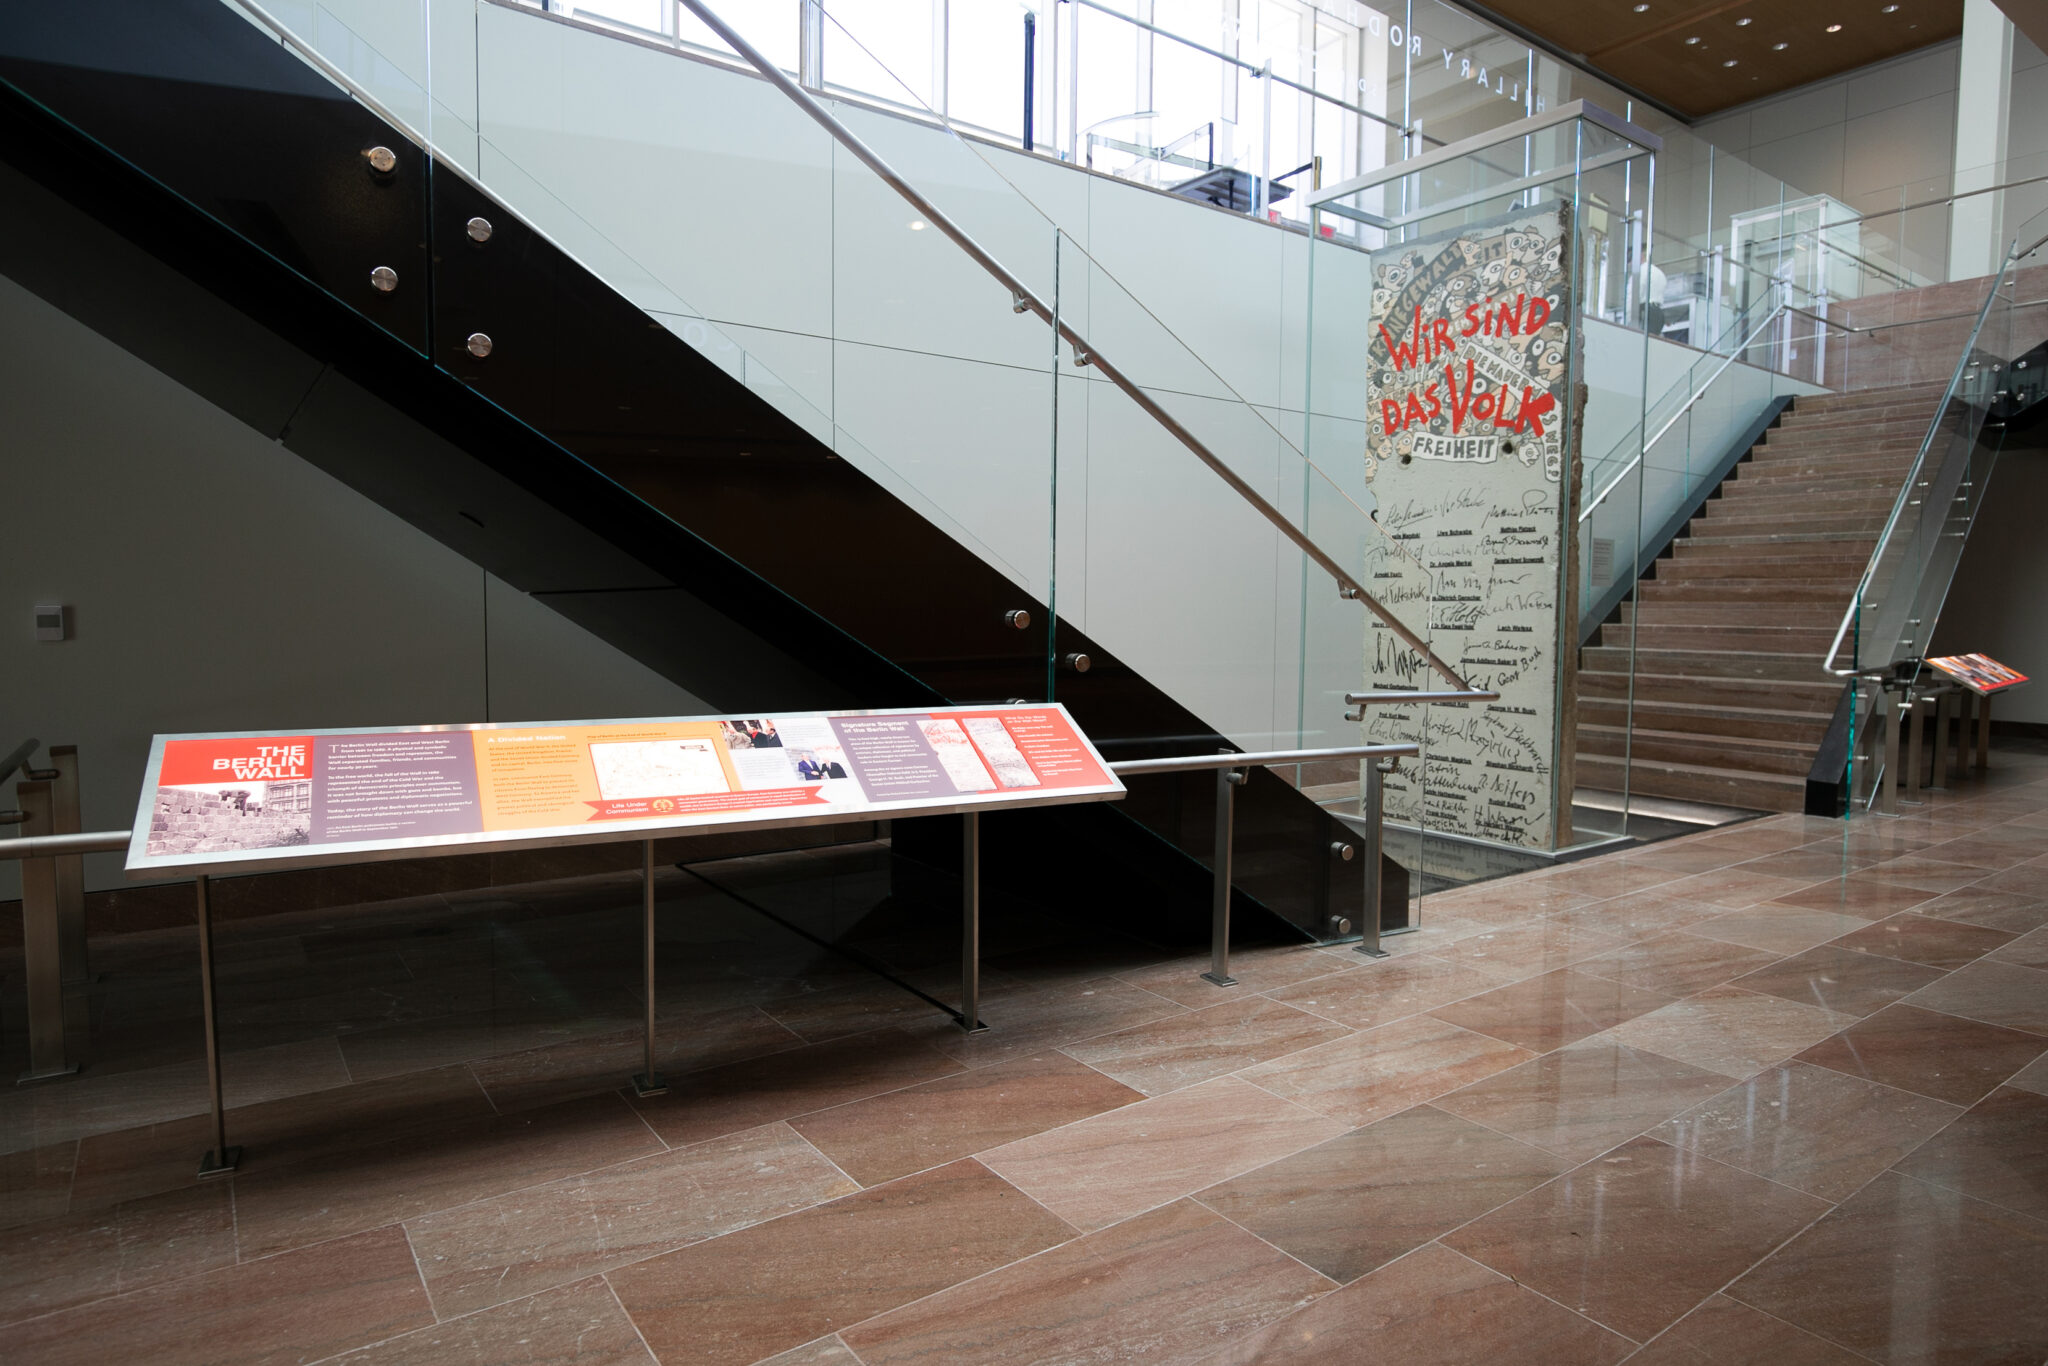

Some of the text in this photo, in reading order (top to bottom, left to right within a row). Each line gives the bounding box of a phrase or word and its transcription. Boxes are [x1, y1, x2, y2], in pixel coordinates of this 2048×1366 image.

[1381, 382, 1442, 435] DAS
[1413, 437, 1495, 459] FREIHEIT
[257, 745, 305, 757] THE
[213, 755, 305, 770] BERLIN
[234, 766, 305, 780] WALL
[605, 806, 649, 815] Communism
